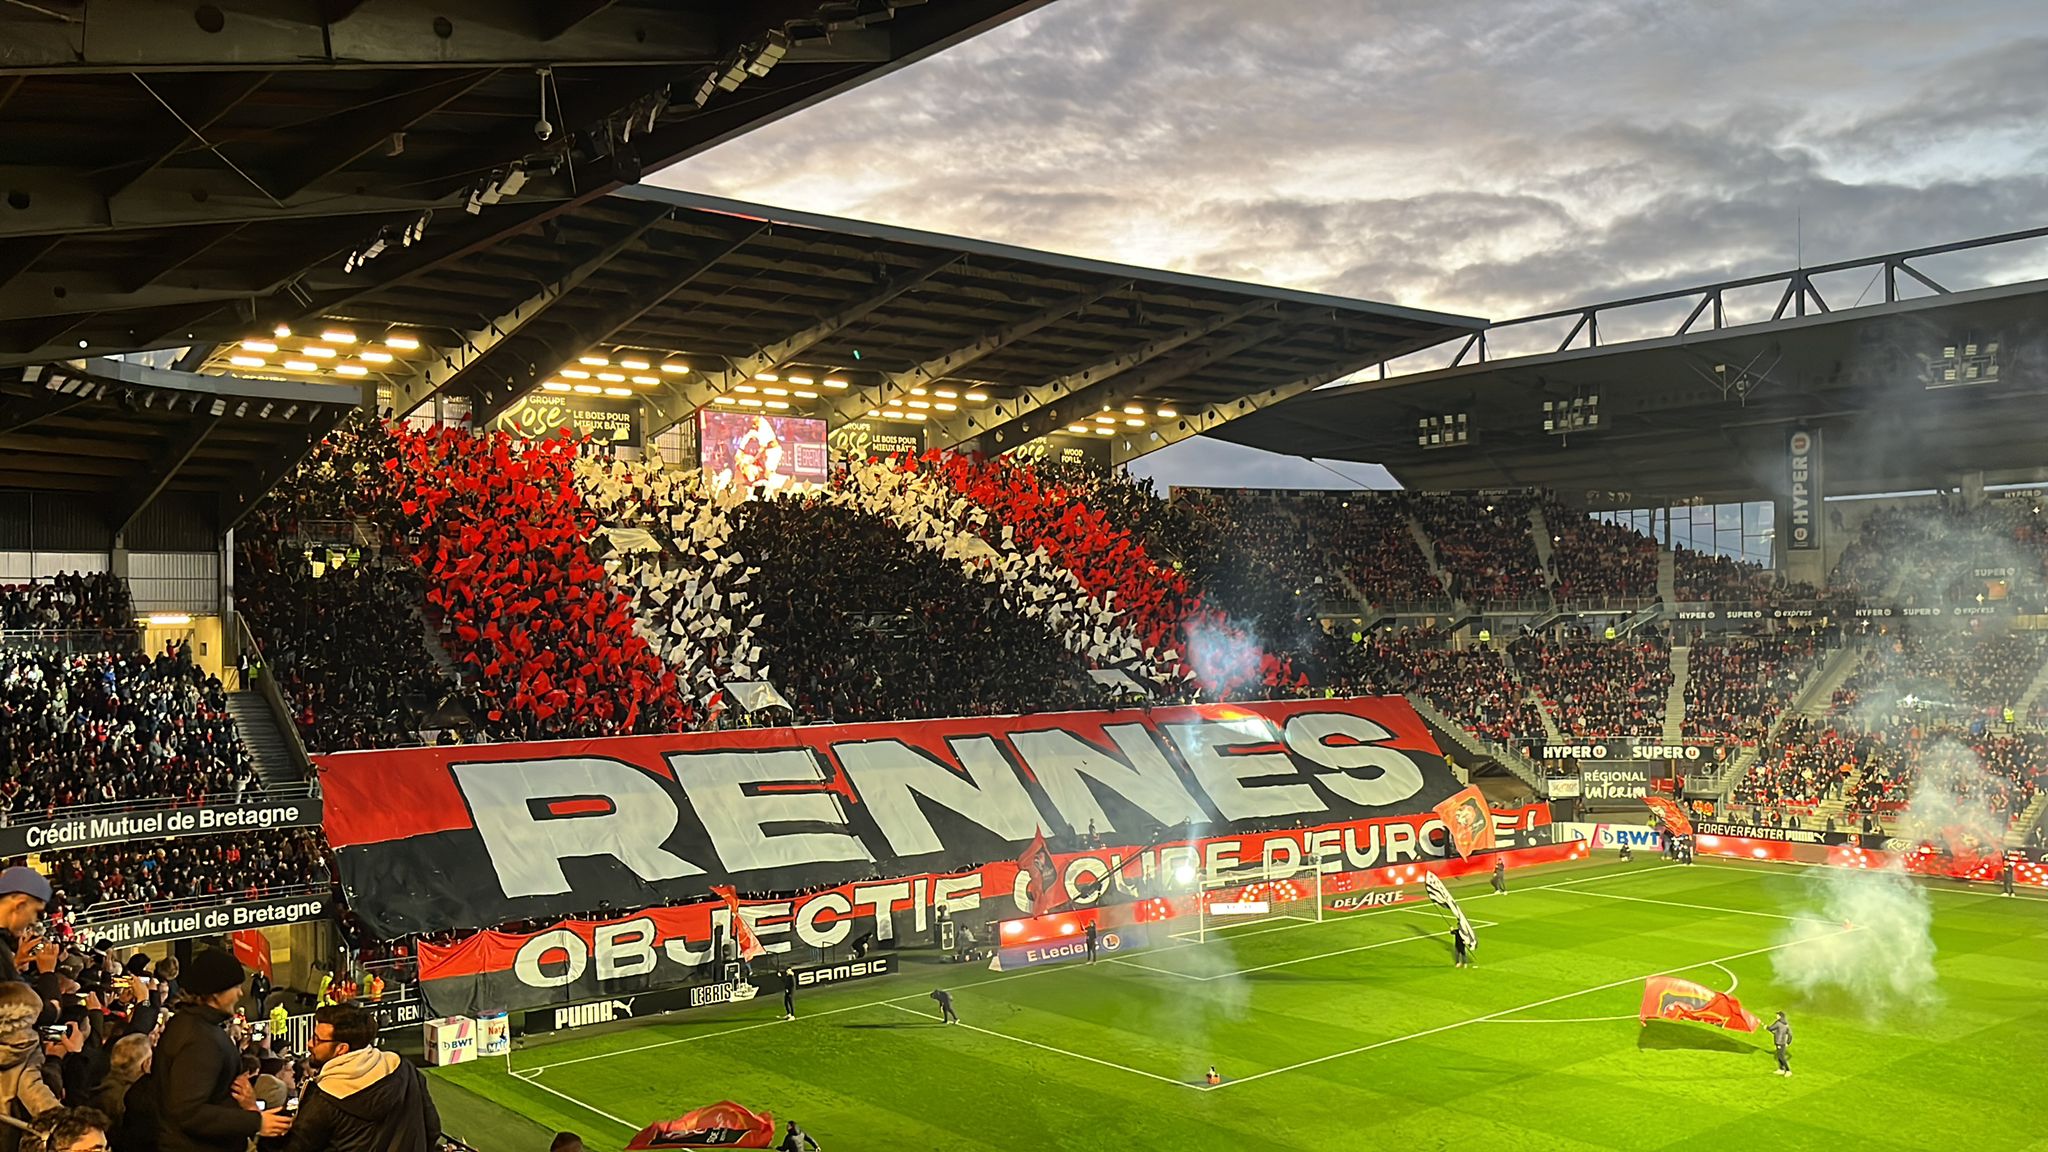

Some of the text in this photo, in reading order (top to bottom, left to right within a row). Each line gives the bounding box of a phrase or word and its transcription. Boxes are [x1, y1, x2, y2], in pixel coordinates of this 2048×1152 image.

[529, 395, 566, 406] GROUPE
[496, 396, 567, 439] Rose
[573, 410, 630, 422] LE BOIS POUR
[573, 420, 630, 431] MIEUX BÂTIR
[842, 422, 871, 431] ROUPE
[872, 434, 917, 445] LE BOIS POUR
[872, 443, 895, 452] MIEUX
[1063, 448, 1084, 457] WOOD
[1792, 455, 1809, 524] HYPER
[1679, 611, 1707, 619] HYPER
[1783, 609, 1813, 618] express
[1903, 608, 1931, 616] SUPER
[1543, 746, 1592, 759] HYPER
[1632, 746, 1684, 759] SUPER
[1584, 769, 1647, 782] RÉGIONAL
[451, 713, 1425, 898] RENNES
[26, 807, 299, 847] Crédit Mutuel de Bretagne
[1617, 831, 1660, 846] BWT
[514, 873, 982, 988] OBJECTIF
[1263, 814, 1519, 879] D'EUROE
[133, 912, 201, 939] Mutuel
[204, 910, 230, 928] de
[233, 901, 322, 924] Bretagne
[798, 959, 887, 985] SAMSIC
[451, 1037, 473, 1049] BWT
